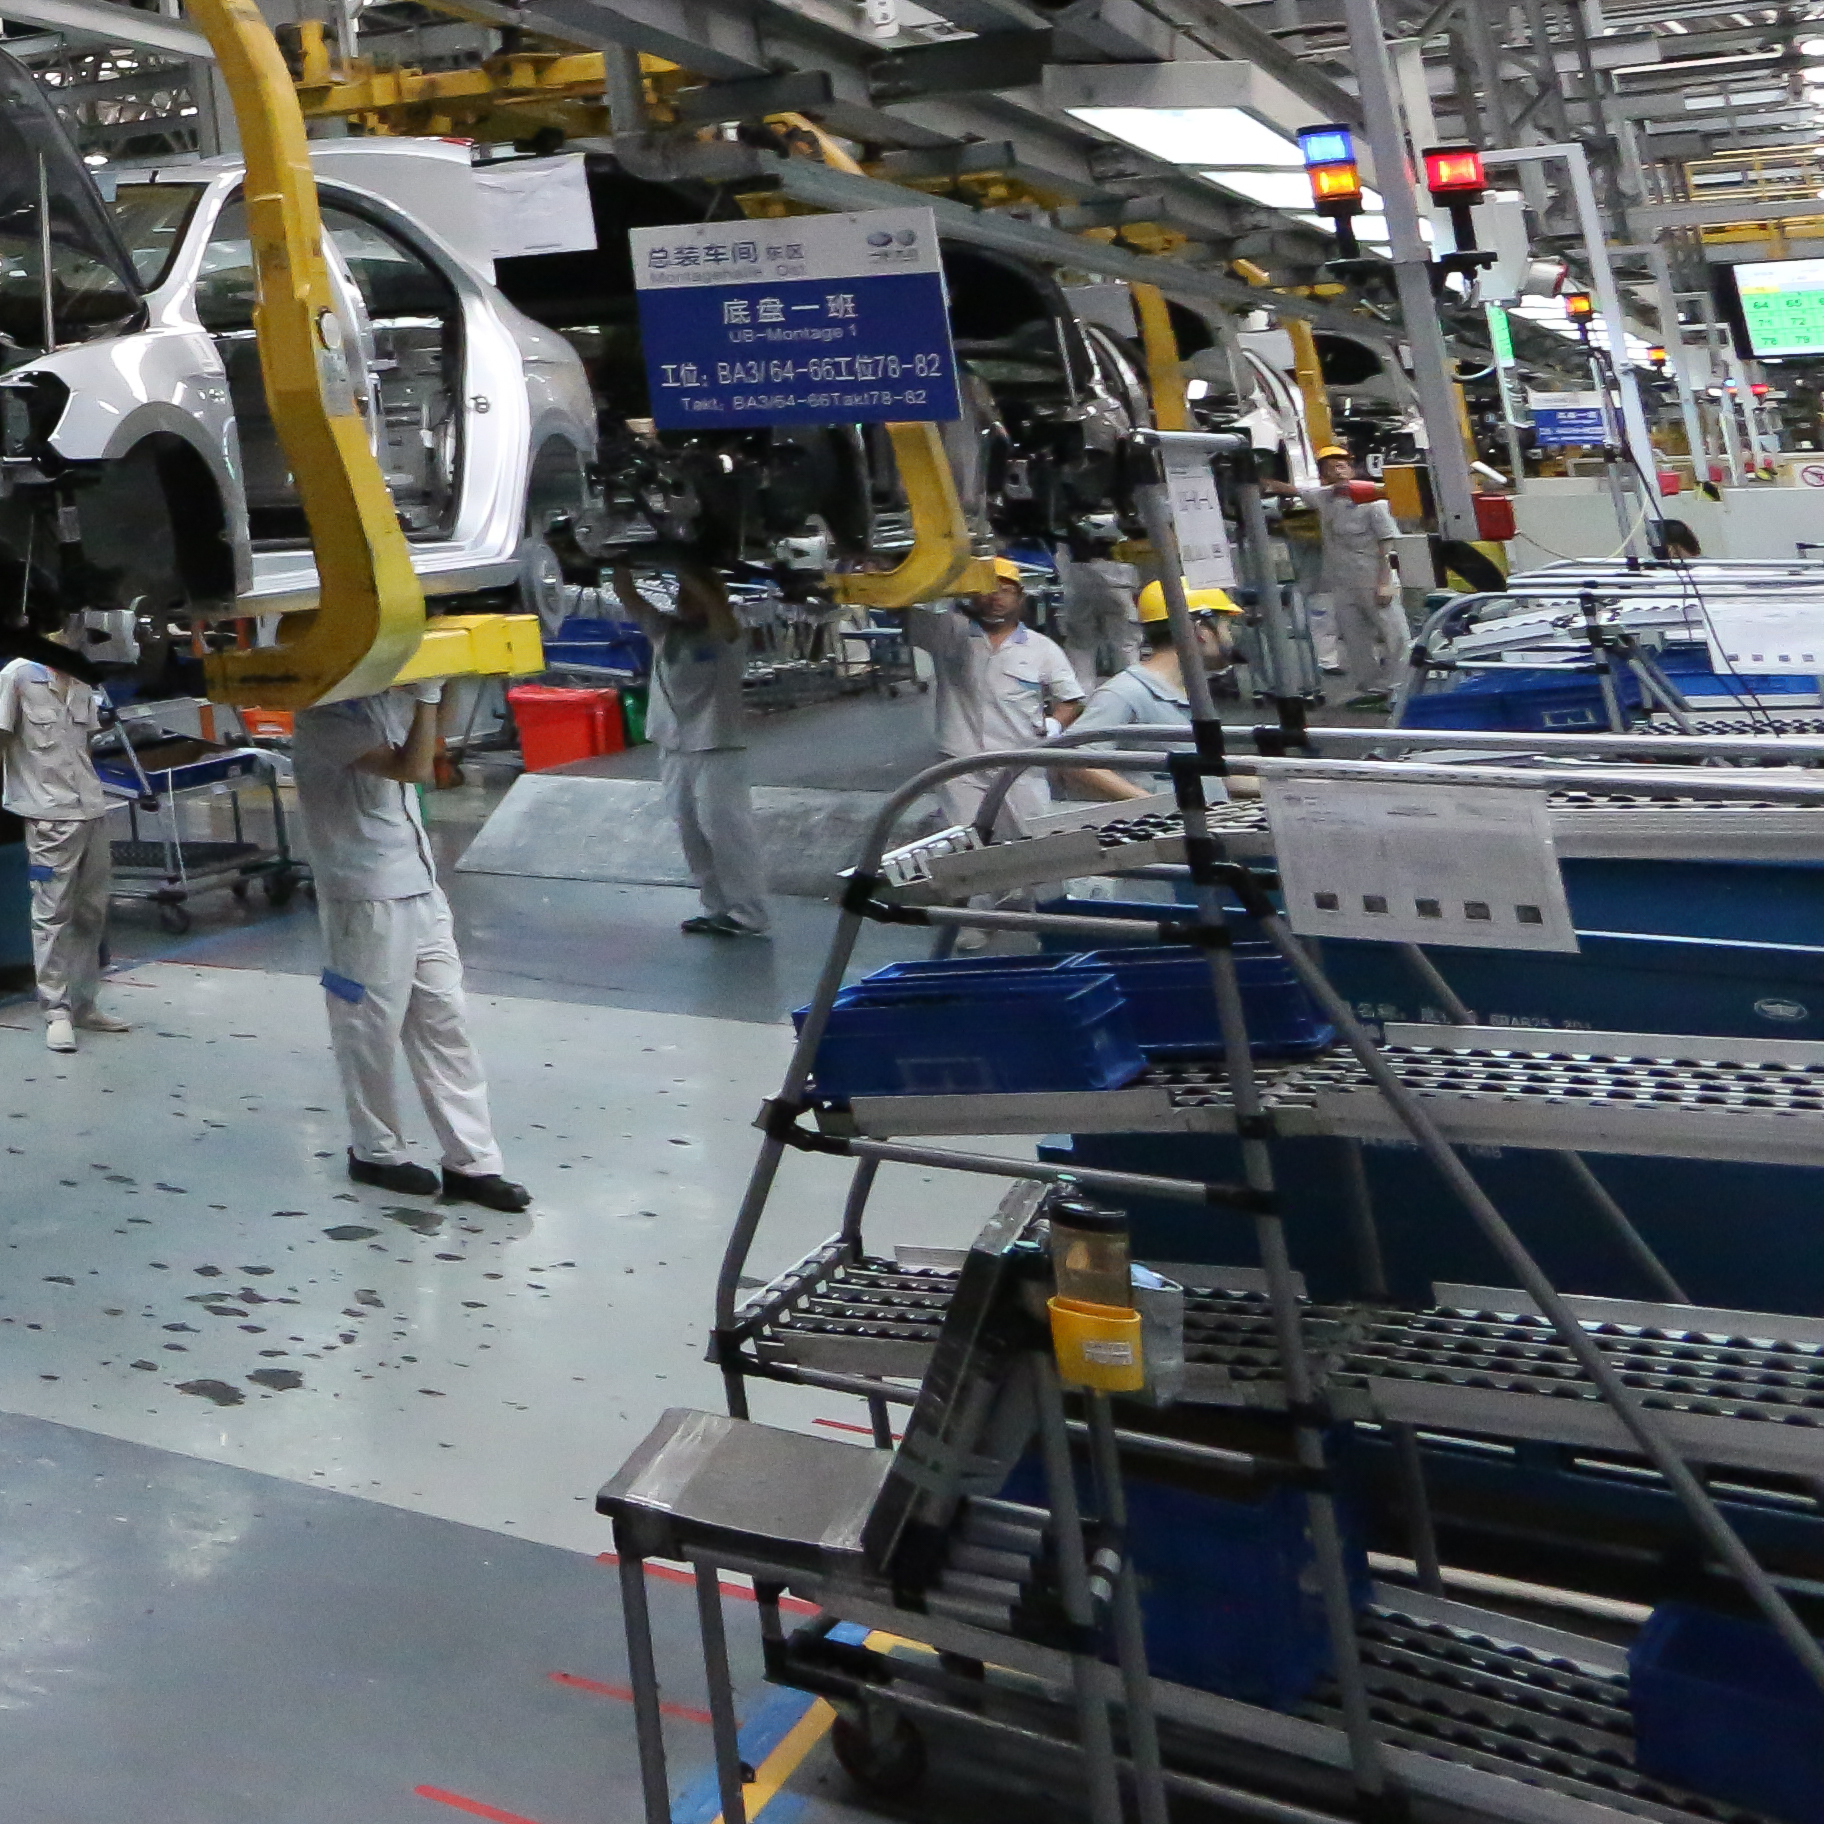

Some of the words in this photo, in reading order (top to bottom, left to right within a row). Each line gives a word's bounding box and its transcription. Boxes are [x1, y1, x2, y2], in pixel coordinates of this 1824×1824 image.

[647, 240, 758, 269] 总装车间
[722, 293, 859, 325] 底盘一班
